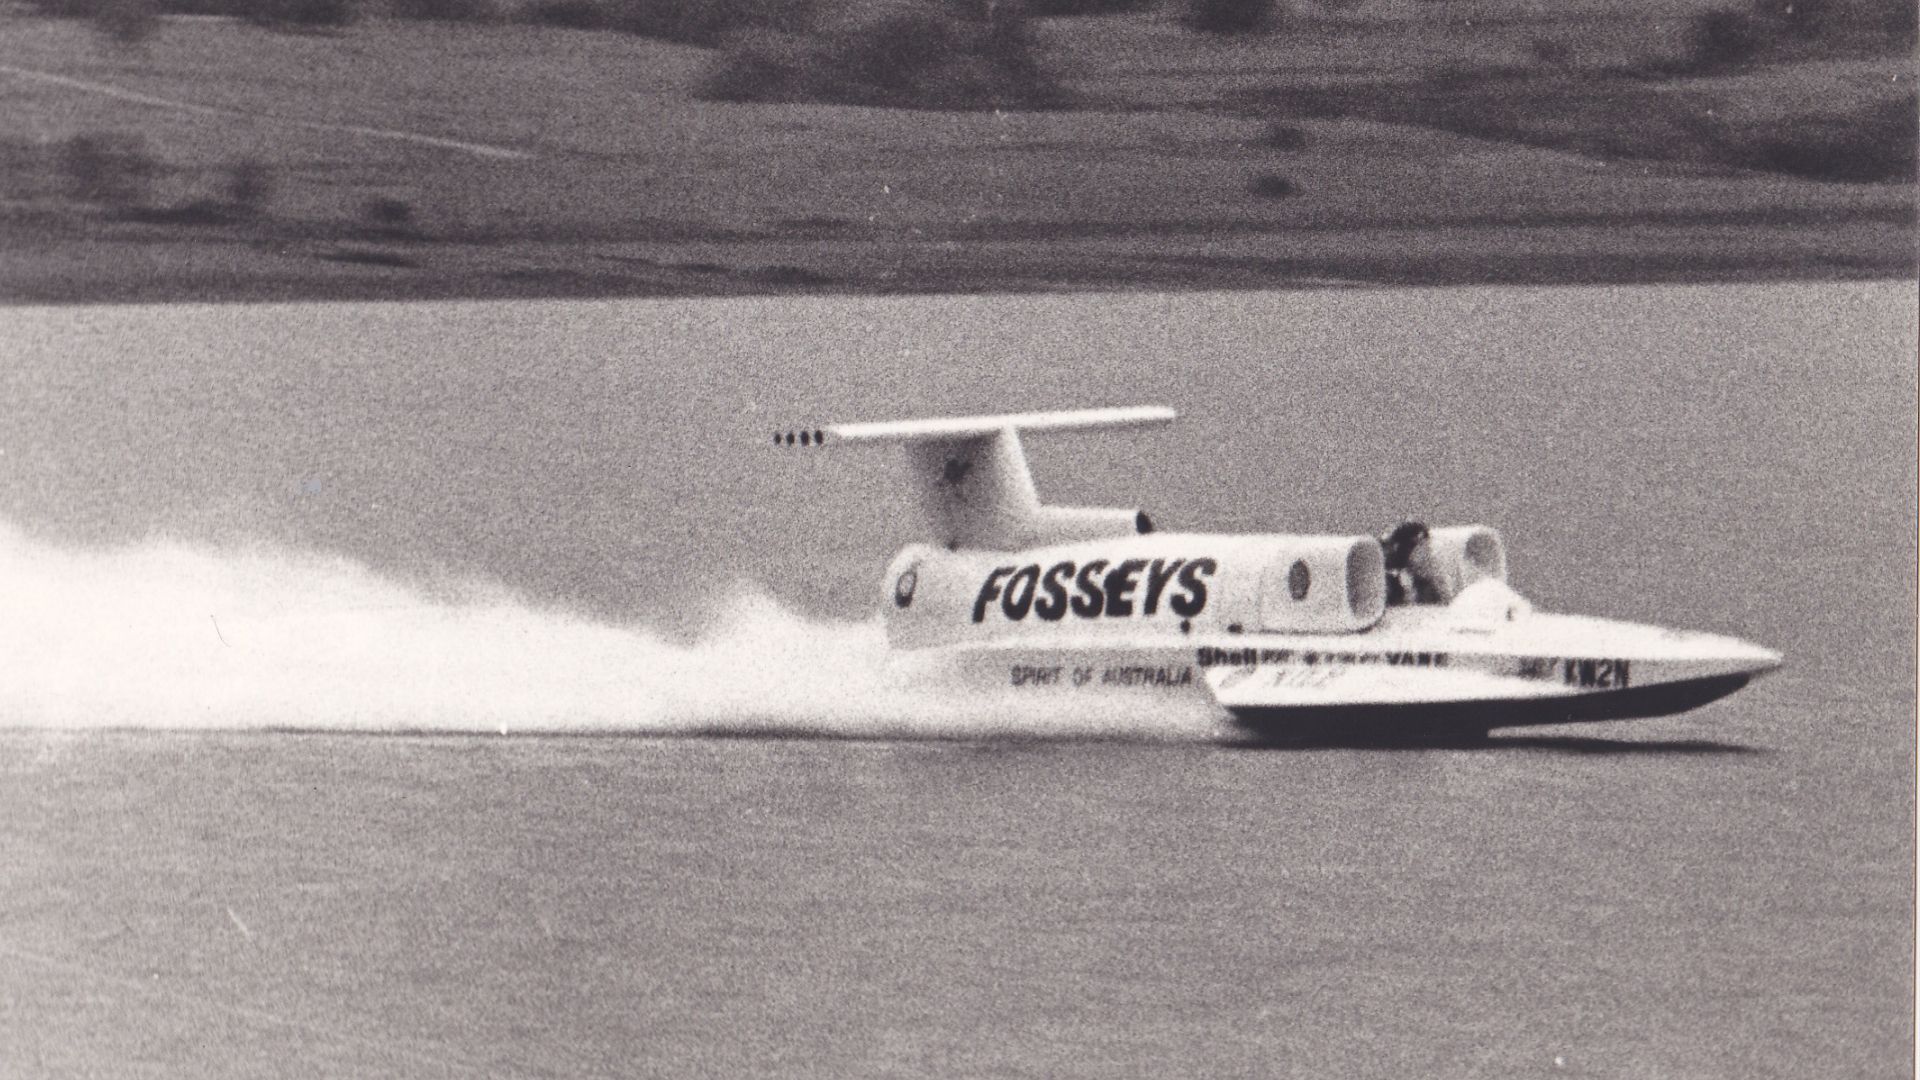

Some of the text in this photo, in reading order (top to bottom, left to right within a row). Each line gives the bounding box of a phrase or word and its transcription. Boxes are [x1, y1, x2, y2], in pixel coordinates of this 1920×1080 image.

[972, 557, 1217, 623] FOSSEYS
[1011, 664, 1192, 686] SPIRIT OF AUSTRALIA
